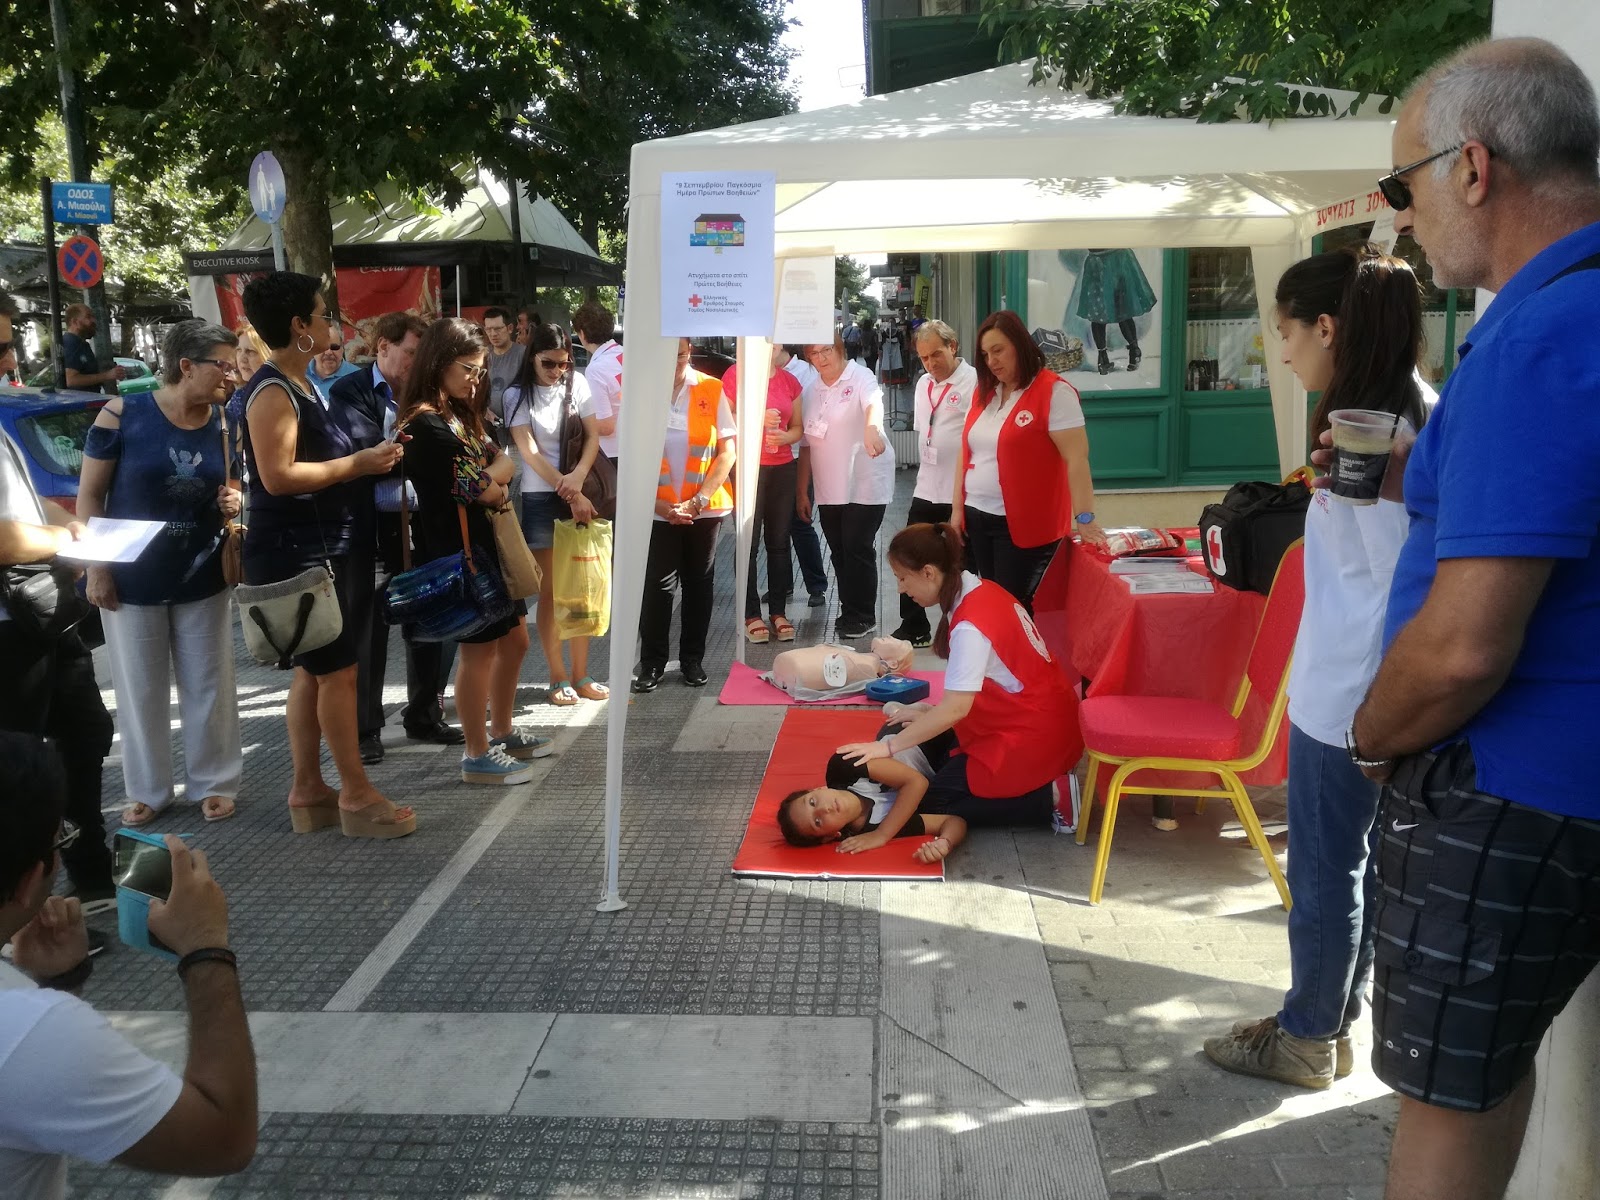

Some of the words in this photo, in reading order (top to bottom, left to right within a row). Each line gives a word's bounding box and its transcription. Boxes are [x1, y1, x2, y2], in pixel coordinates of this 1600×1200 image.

[683, 181, 724, 189] Σεπτεμβρίου
[727, 181, 762, 189] Παγκόσμια
[67, 188, 95, 200] ΟΔΟΣ
[57, 200, 67, 210] Α.
[68, 200, 106, 213] Μιαούλη
[193, 257, 236, 268] EXECUTIVE
[236, 256, 260, 265] KIOSK
[165, 521, 199, 529] ATRIZIA
